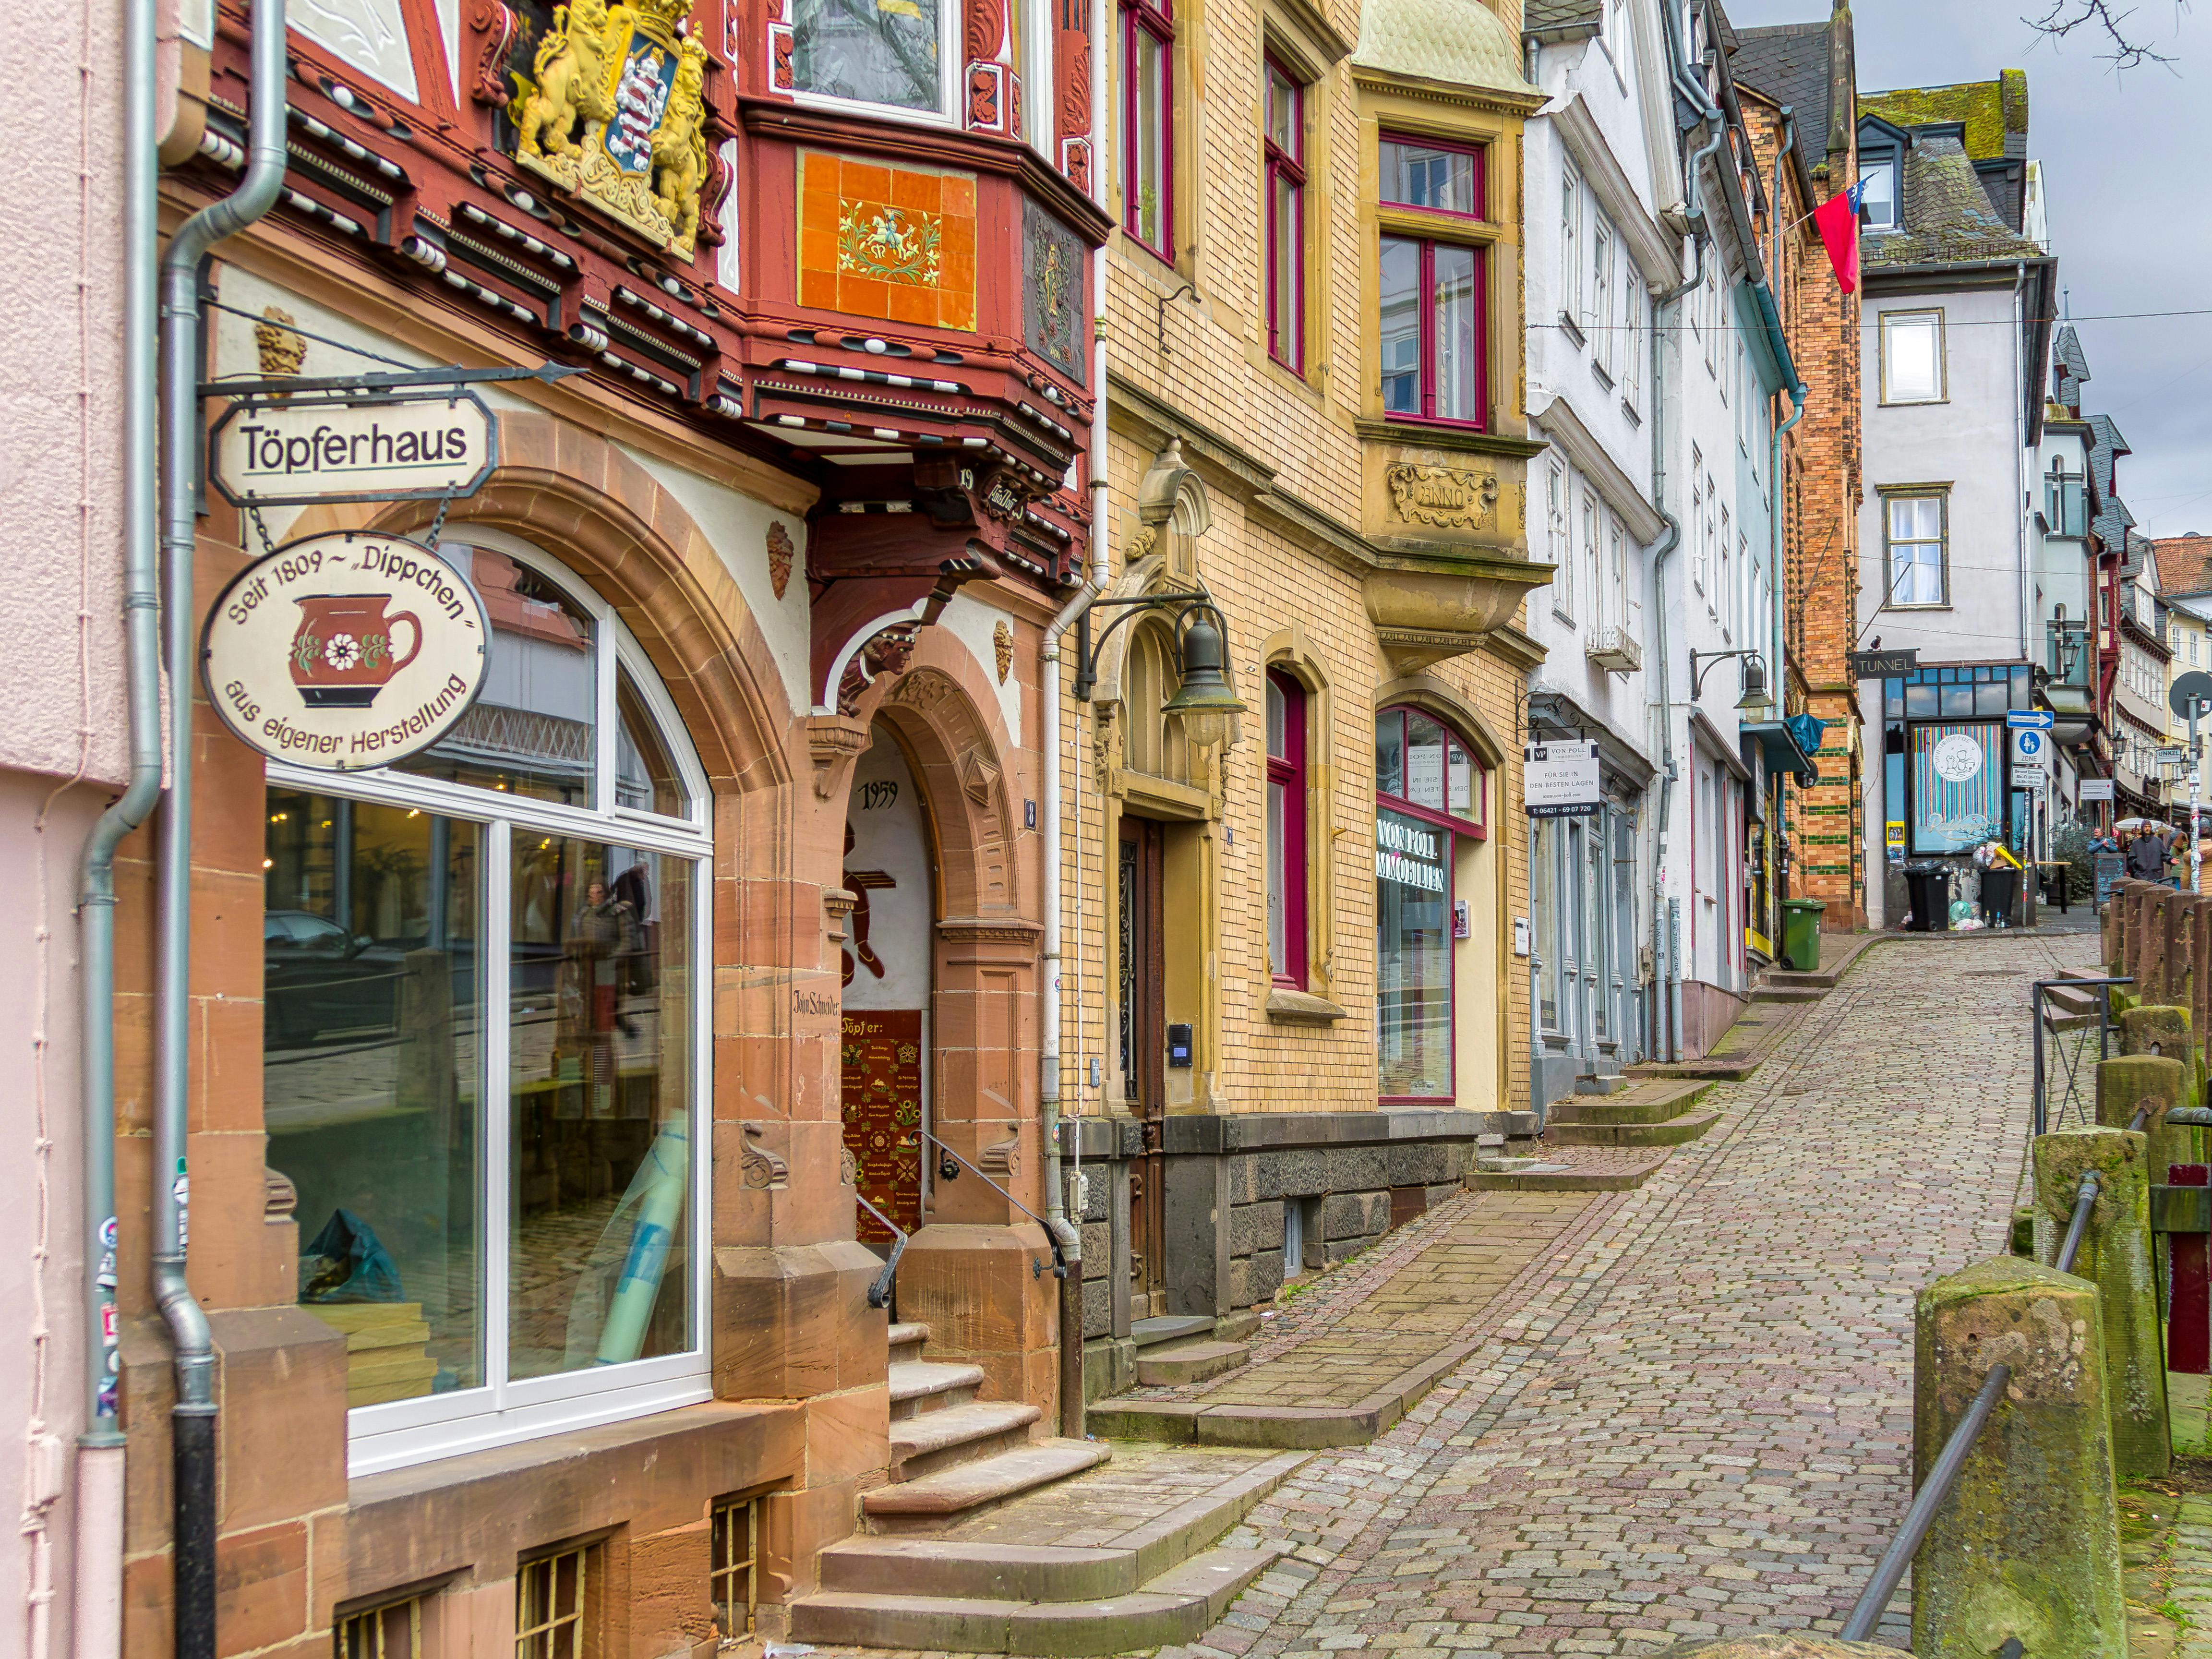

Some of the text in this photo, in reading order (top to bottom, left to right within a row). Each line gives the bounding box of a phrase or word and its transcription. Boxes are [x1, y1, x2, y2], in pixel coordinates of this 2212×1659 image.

[239, 423, 467, 473] Töpferhaus
[960, 469, 973, 490] 19
[1420, 485, 1463, 506] ANNO
[228, 574, 269, 626] Seit
[274, 550, 323, 587] 1809
[1858, 659, 1912, 672] TUNNEL
[226, 672, 467, 754] aus eigener Herstellung
[855, 781, 898, 810] 1959
[1029, 803, 1034, 825] 8
[1376, 819, 1438, 859] VON POLL
[1376, 851, 1444, 893] MMOBILIEN
